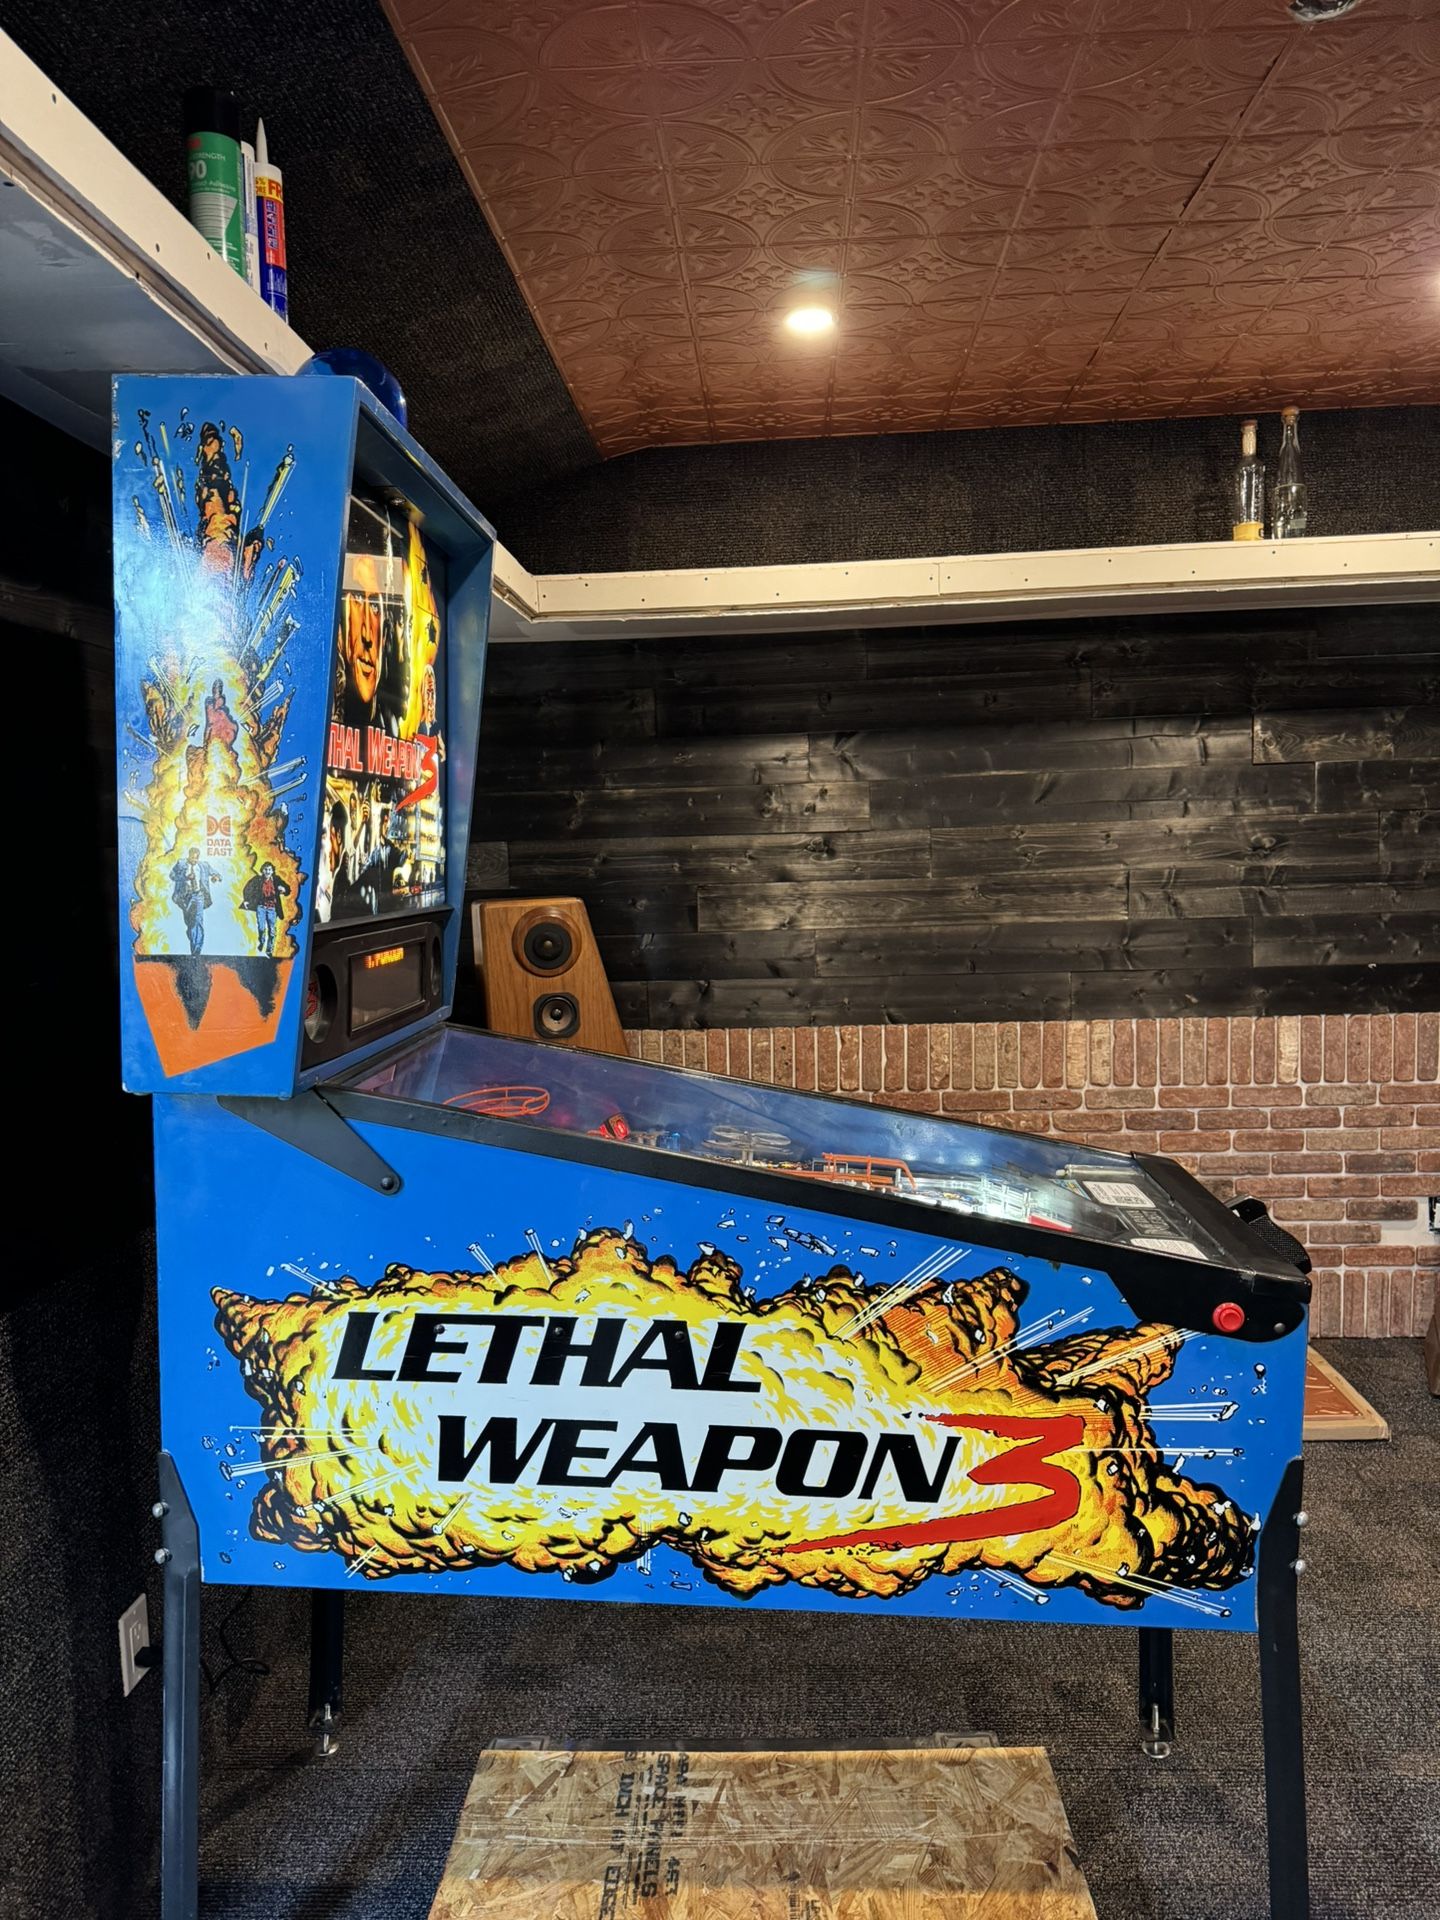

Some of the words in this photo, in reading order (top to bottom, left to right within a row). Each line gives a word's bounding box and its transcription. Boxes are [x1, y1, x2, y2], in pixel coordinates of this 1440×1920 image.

[367, 725, 419, 780] WEAPON
[395, 733, 438, 812] 3
[206, 847, 232, 856] EAST
[332, 1311, 761, 1393] LETHAL
[438, 1415, 962, 1503] WEAPON
[784, 1413, 1086, 1553] 3
[615, 1772, 635, 1817] INCH
[652, 1753, 672, 1810] SPACE
[641, 1823, 664, 1898] PANELS
